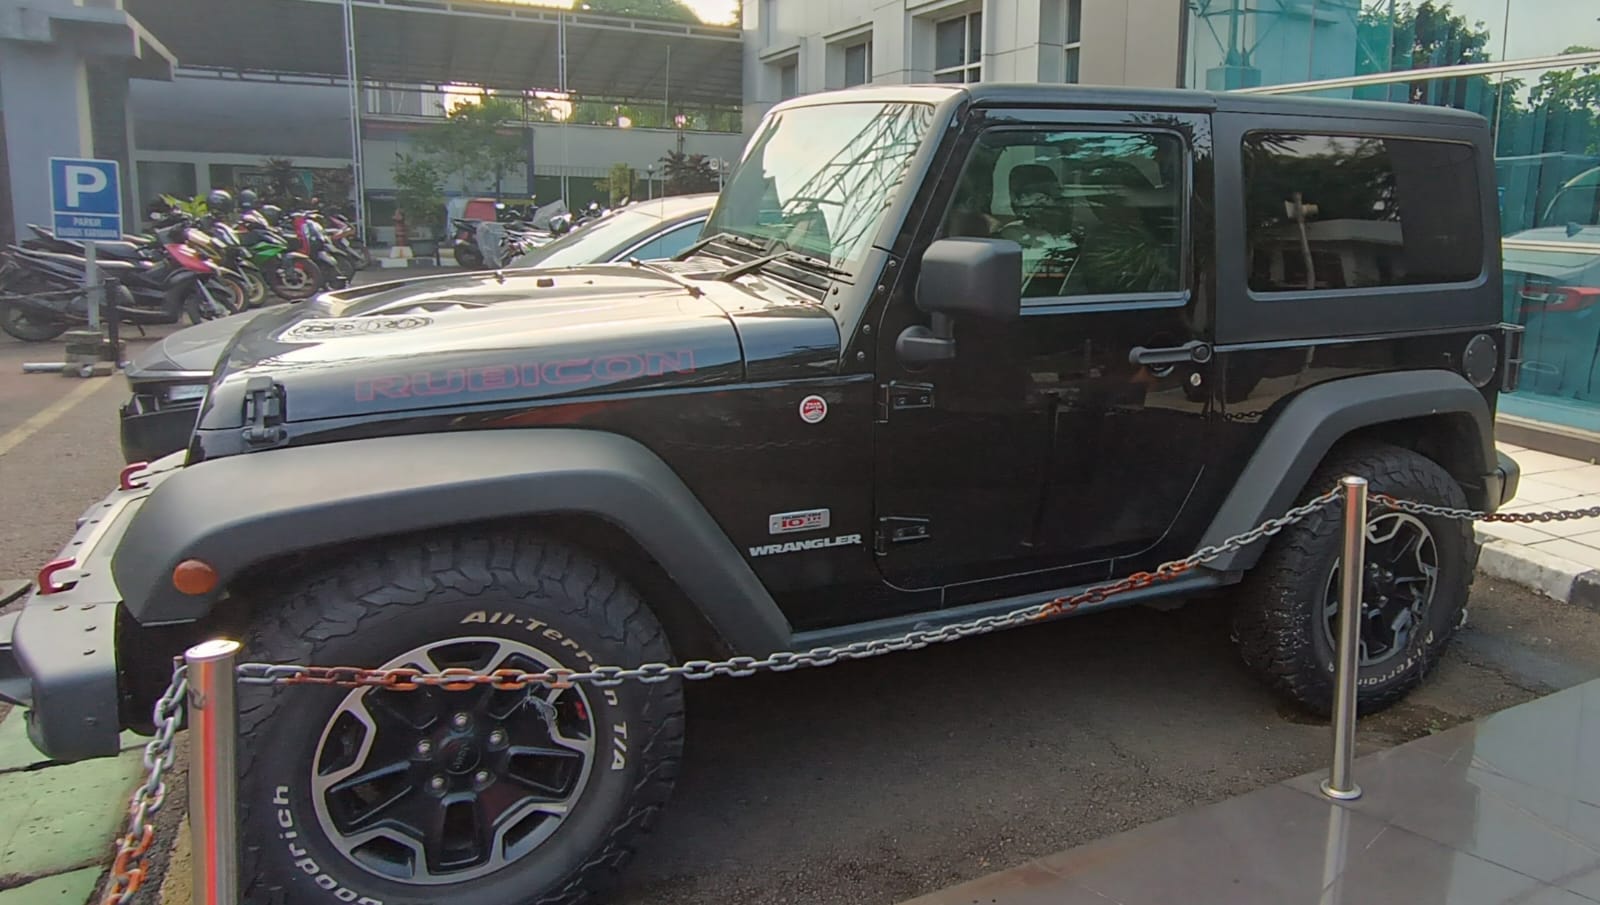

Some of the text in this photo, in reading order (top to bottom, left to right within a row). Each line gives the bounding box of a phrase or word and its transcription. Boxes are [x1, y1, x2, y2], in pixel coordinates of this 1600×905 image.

[65, 165, 107, 207] P
[355, 349, 697, 402] RUBICON
[749, 533, 862, 557] WRANGLER
[460, 610, 628, 770] All-Terrn T/A
